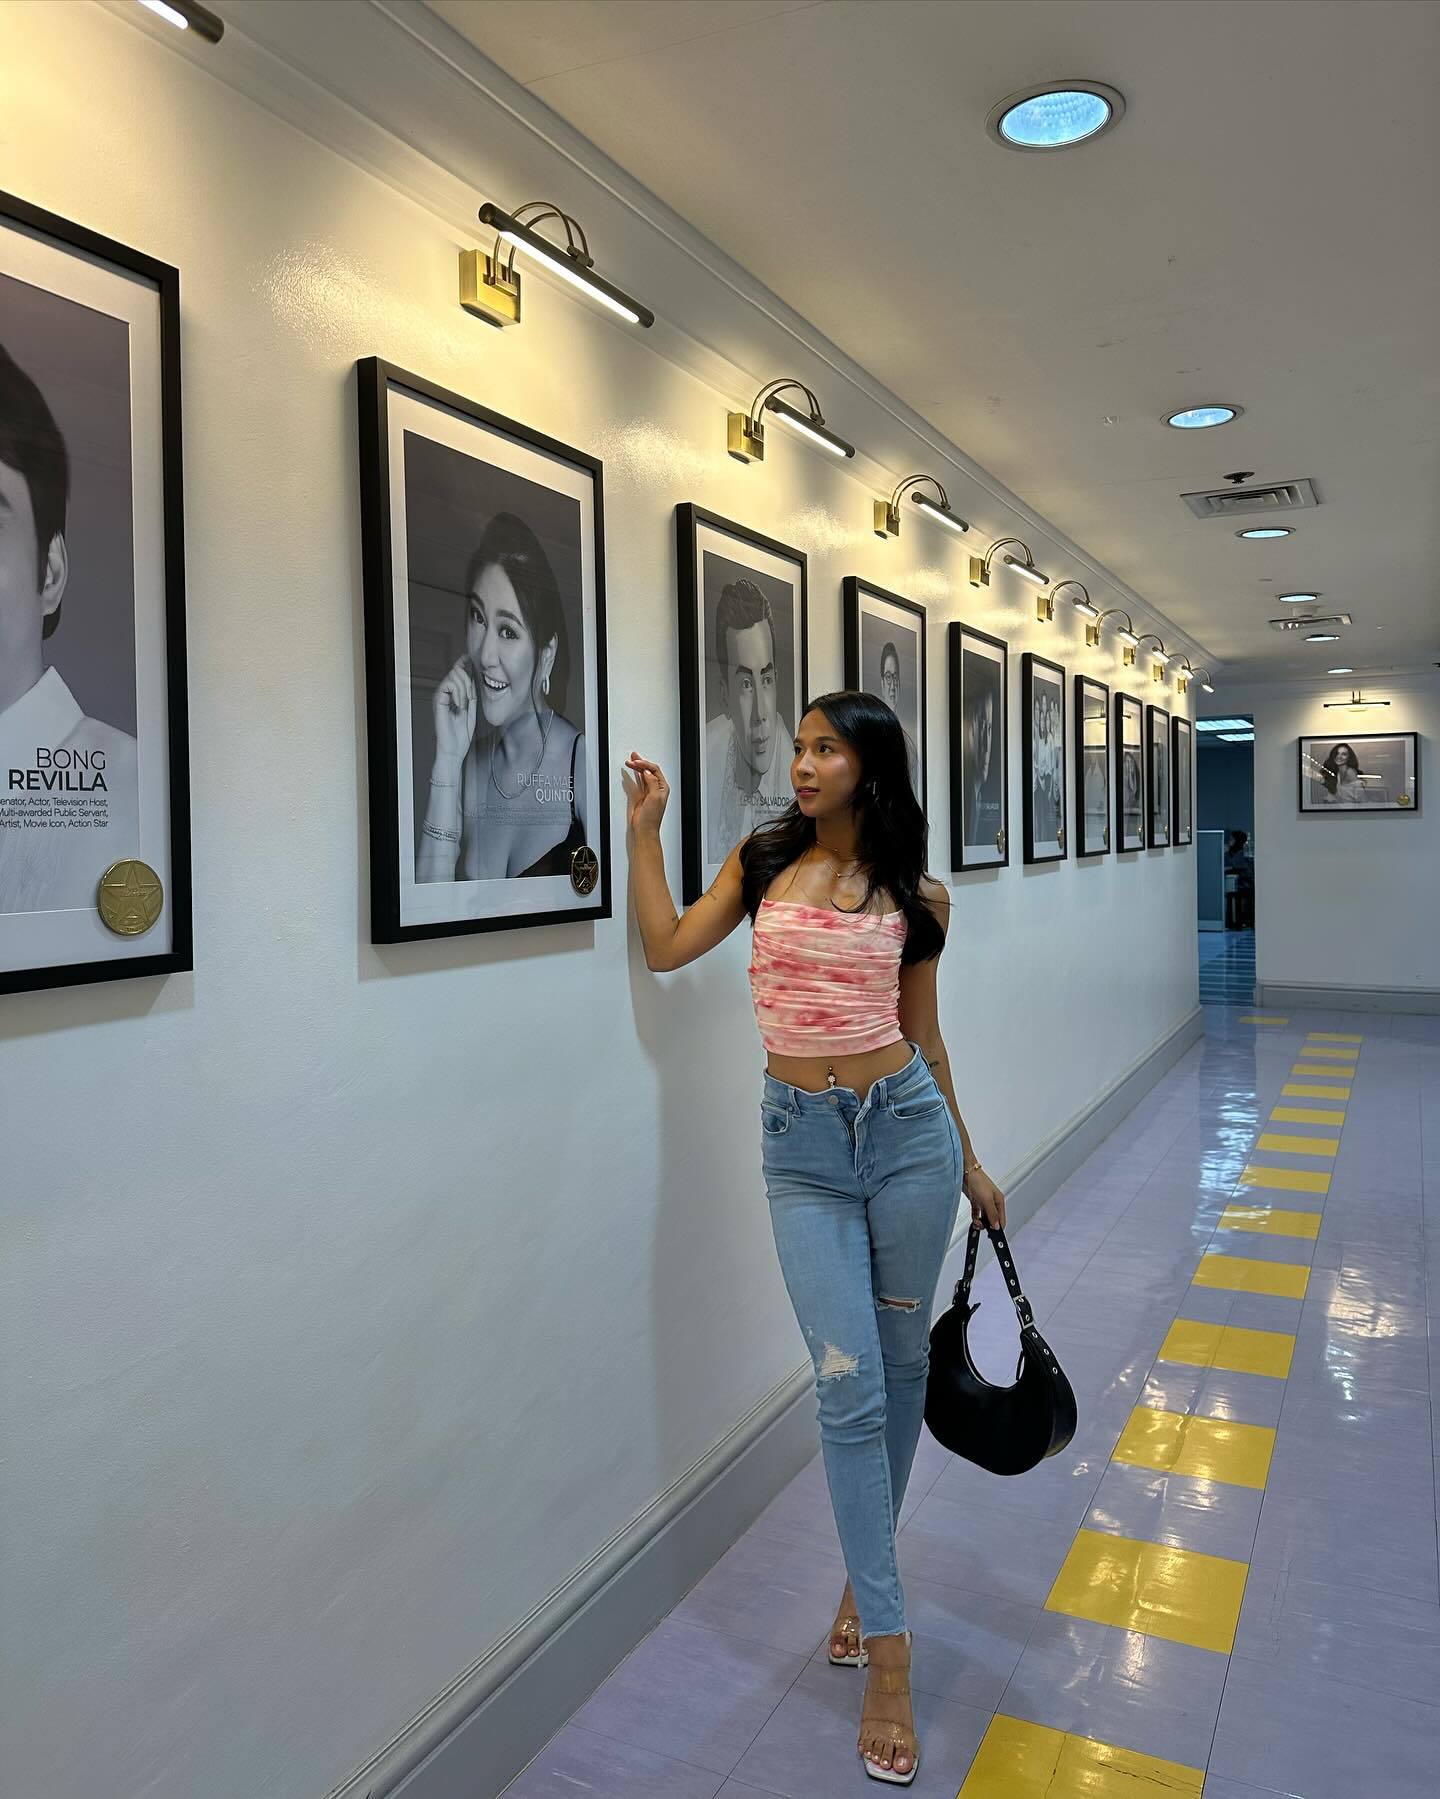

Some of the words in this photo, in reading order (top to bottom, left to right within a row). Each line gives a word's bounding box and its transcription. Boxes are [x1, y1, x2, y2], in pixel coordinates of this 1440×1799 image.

[37, 747, 106, 770] BONG
[9, 769, 108, 792] REVILLA
[517, 772, 551, 788] RUFFA
[553, 775, 574, 789] MAE
[0, 797, 27, 807] enator,
[28, 797, 51, 807] Actor,
[52, 797, 88, 807] Television
[90, 797, 108, 807] Host,
[535, 788, 574, 804] QUINTO
[760, 796, 790, 807] SALVADOR
[54, 808, 77, 817] Public
[79, 808, 108, 818] Servant,
[24, 819, 47, 828] Movie
[68, 819, 92, 828] Action
[94, 818, 108, 828] Star
